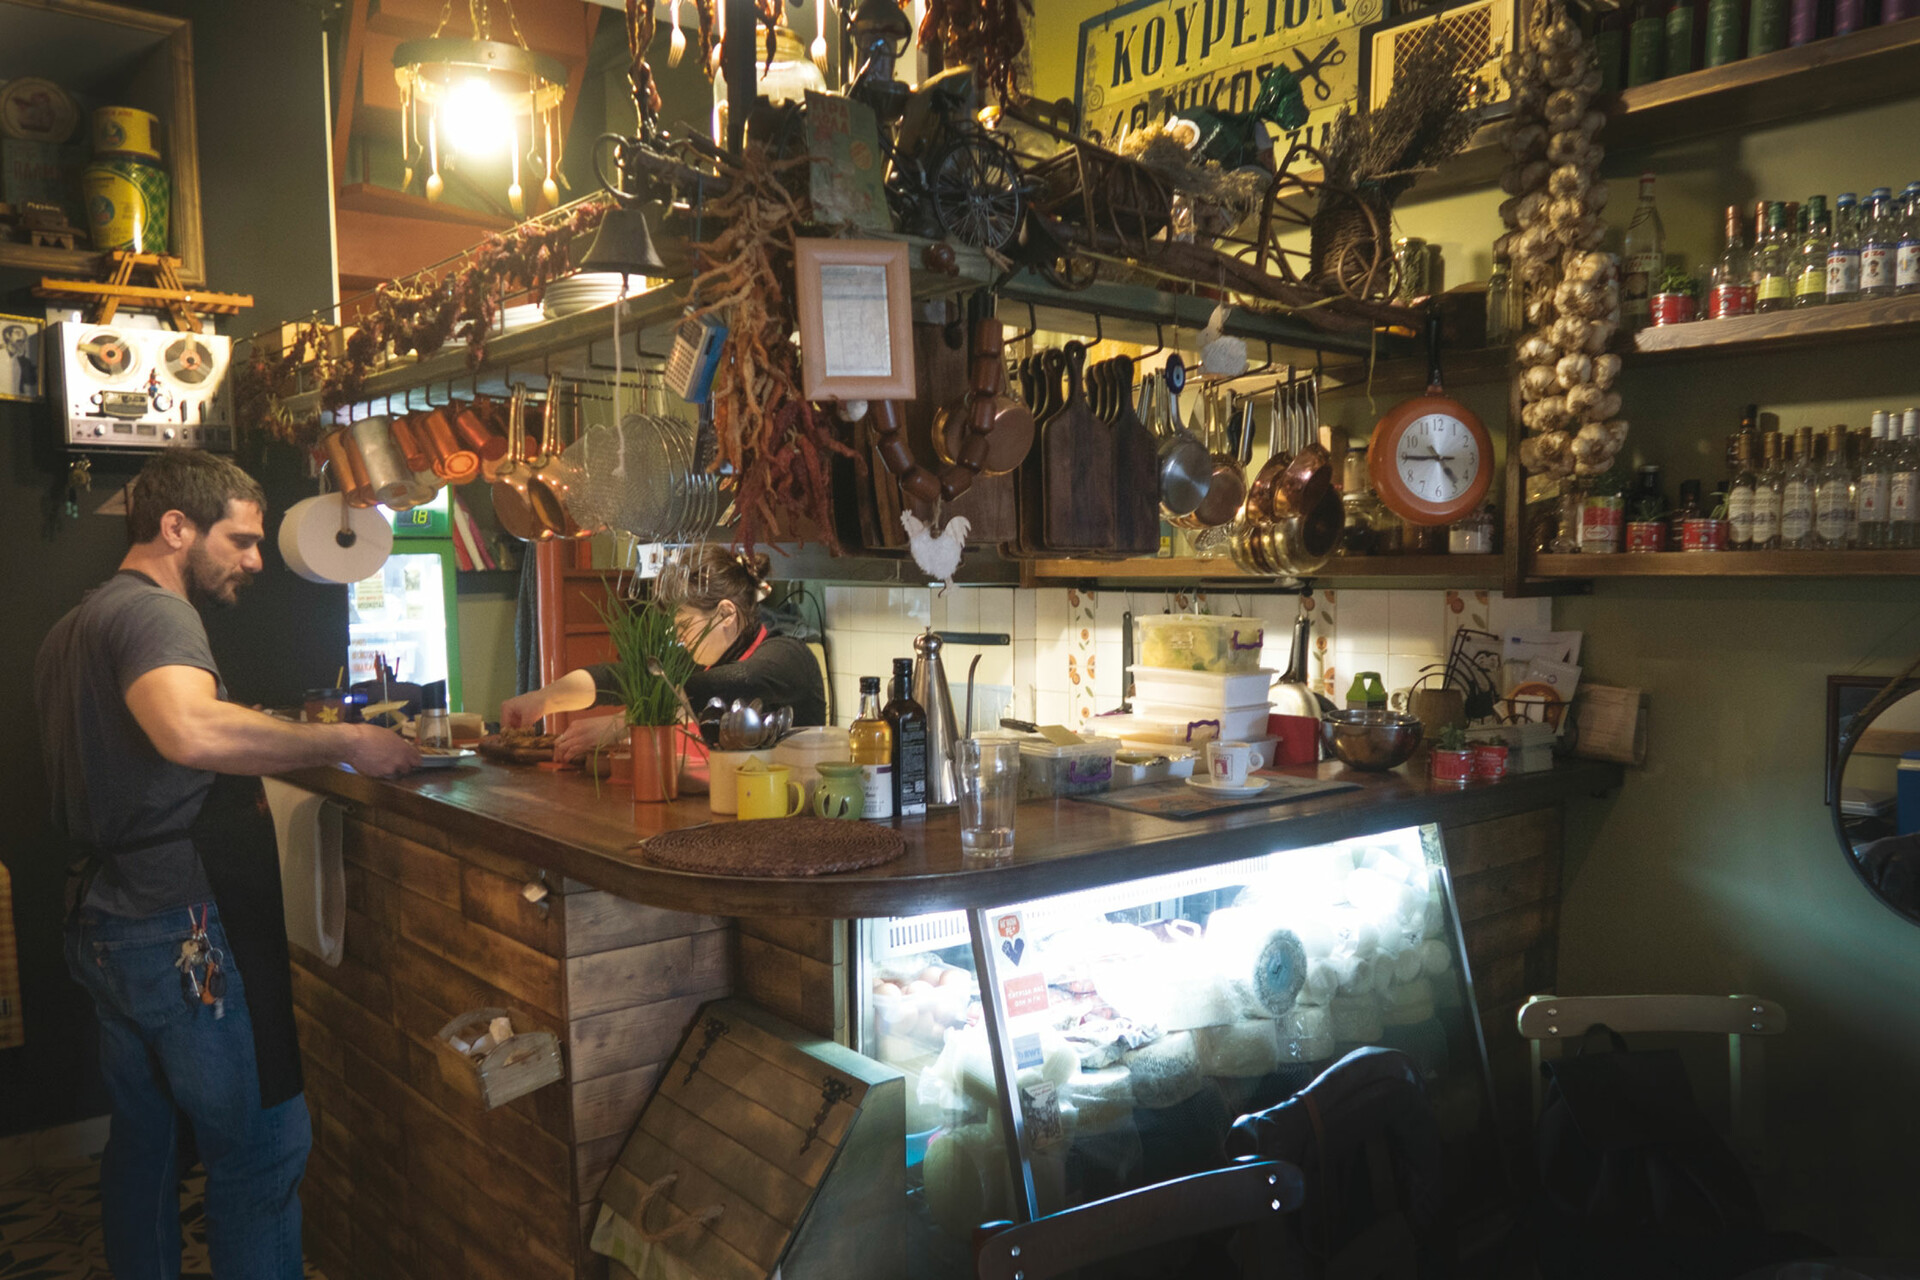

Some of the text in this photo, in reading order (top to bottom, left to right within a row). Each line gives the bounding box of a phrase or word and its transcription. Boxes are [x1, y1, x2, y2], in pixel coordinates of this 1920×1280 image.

[1420, 422, 1429, 435] 11
[1433, 418, 1444, 432] 12
[1453, 423, 1456, 436] 1
[1406, 435, 1418, 449] 10
[1463, 435, 1469, 448] 2
[1469, 452, 1475, 465] 3
[1407, 469, 1414, 482] 8
[1463, 469, 1469, 481] 4
[1419, 480, 1426, 493] 7
[1435, 484, 1442, 498] 6
